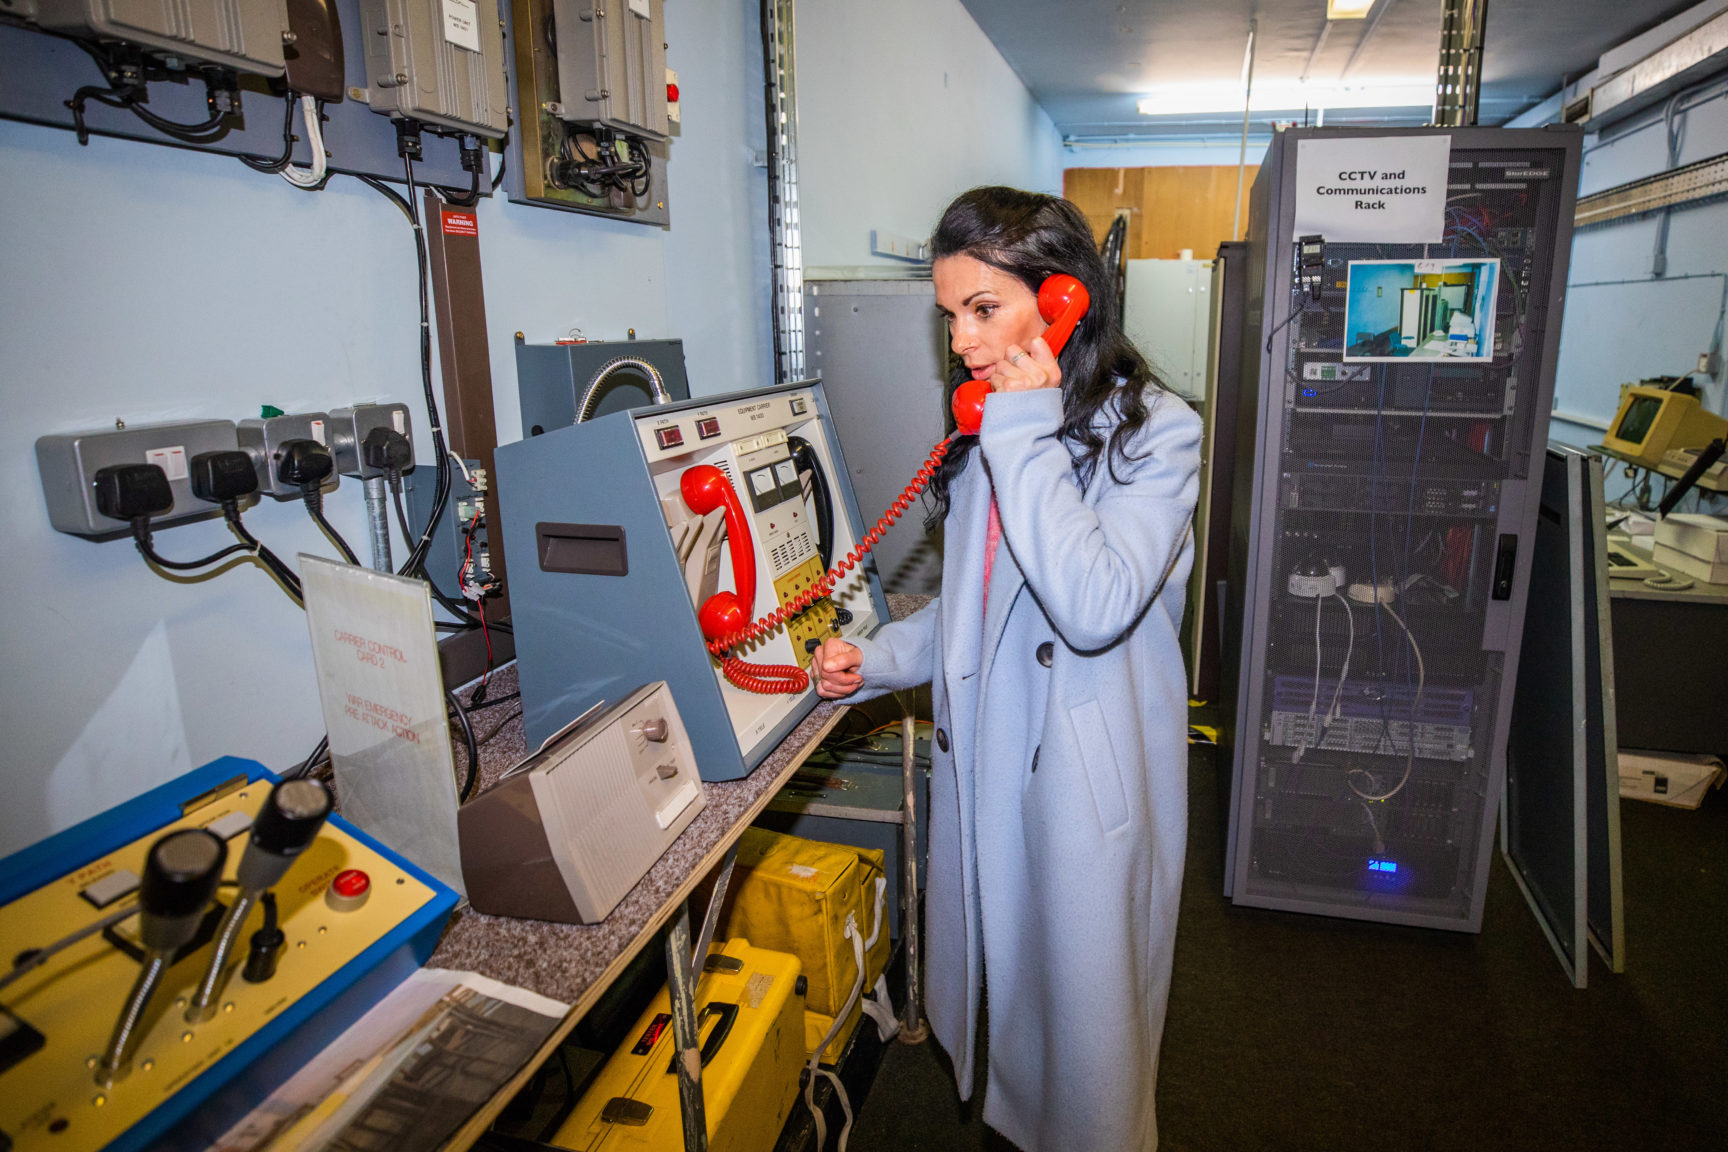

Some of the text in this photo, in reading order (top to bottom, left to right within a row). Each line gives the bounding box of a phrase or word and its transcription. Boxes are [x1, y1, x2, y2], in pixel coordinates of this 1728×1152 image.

[1338, 169, 1406, 181] CCTV and
[1316, 185, 1427, 196] Communications
[1354, 200, 1386, 210] Rack
[447, 218, 474, 227] WARNING
[334, 629, 408, 664] CARRIER CONTROL
[356, 648, 385, 669] CARD 2
[364, 699, 412, 731] EMERGENCY
